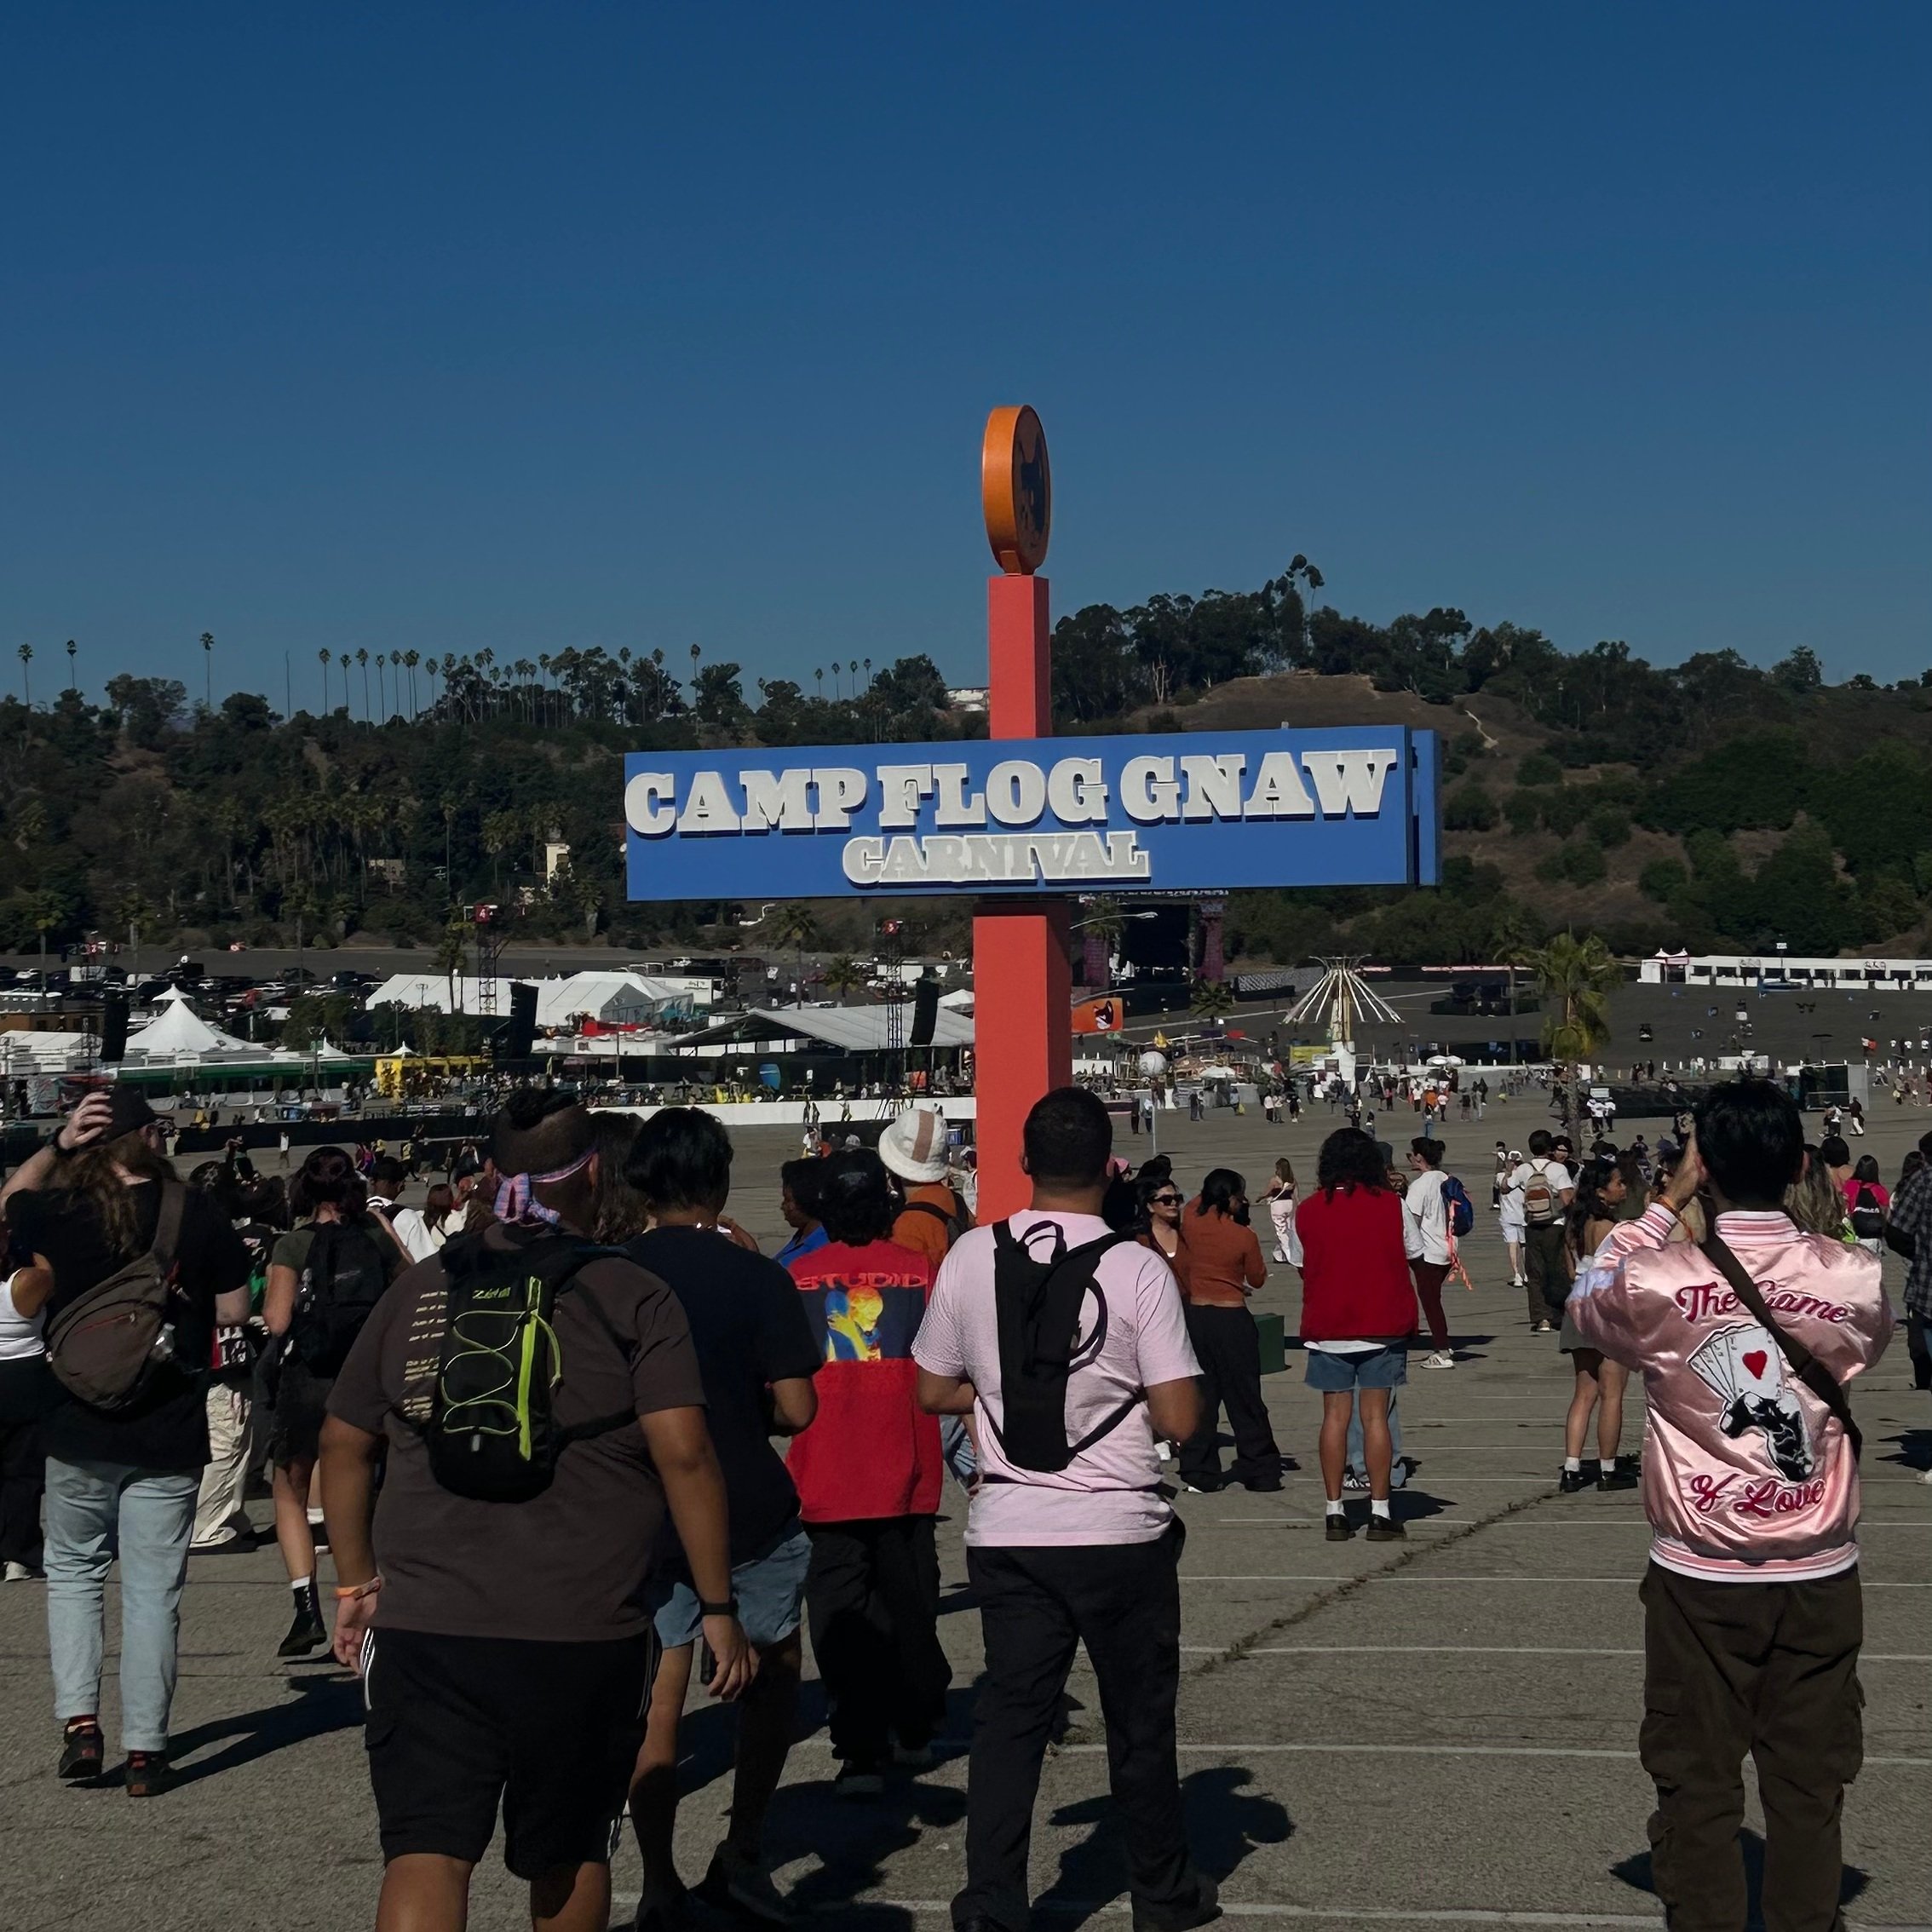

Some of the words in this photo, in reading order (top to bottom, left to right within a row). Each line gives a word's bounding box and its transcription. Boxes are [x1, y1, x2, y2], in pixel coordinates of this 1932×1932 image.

[624, 768, 867, 835] CAMP
[877, 757, 1108, 828] FLOG
[1120, 749, 1397, 821] GNAW
[842, 831, 1150, 884] CARNIVAL
[1675, 1281, 1739, 1322] The
[1690, 1473, 1741, 1513] of
[1733, 1478, 1826, 1519] Love
